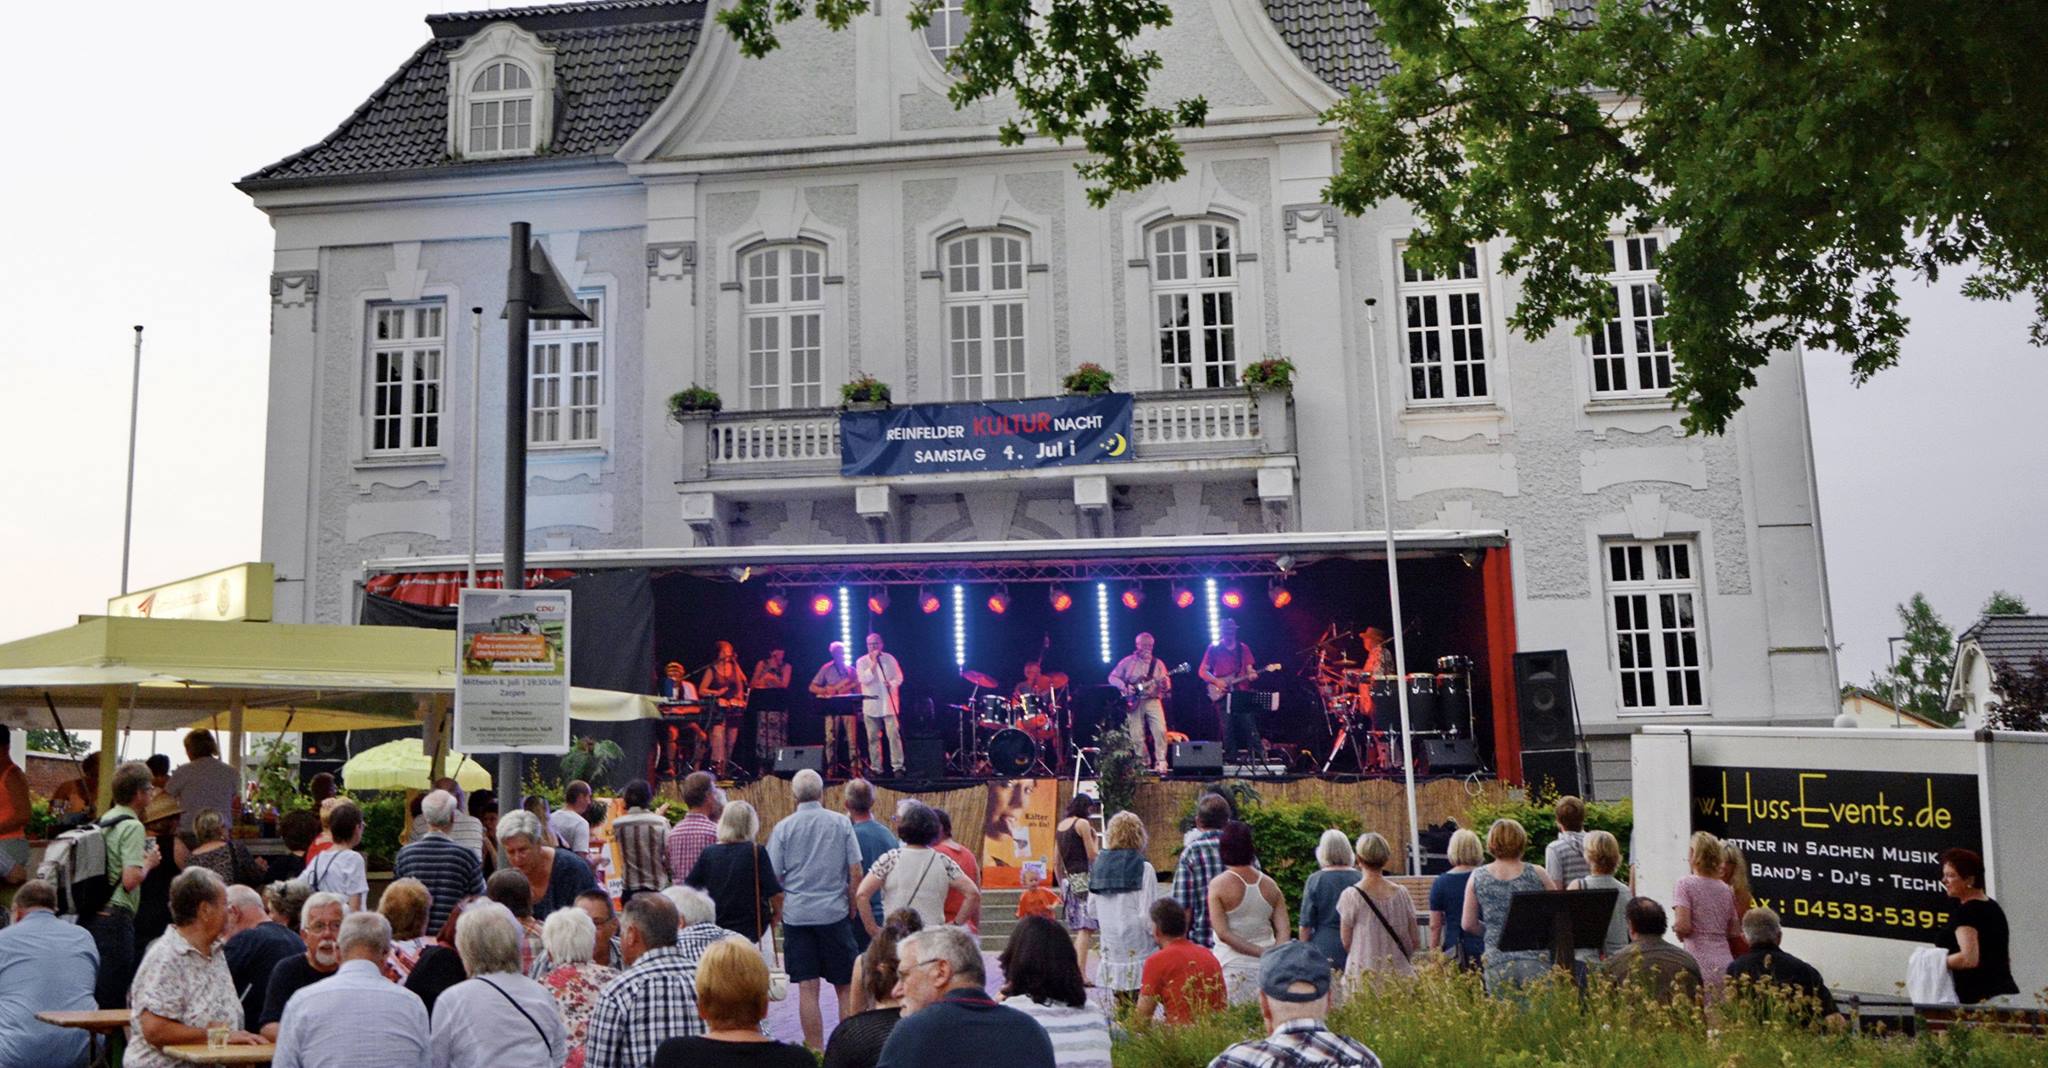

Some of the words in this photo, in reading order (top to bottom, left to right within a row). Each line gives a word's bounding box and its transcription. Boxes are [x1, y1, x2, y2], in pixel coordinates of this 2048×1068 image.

[886, 425, 965, 441] REINFELDER
[972, 412, 1051, 437] KULTUR
[1053, 415, 1103, 432] NACHT
[914, 448, 986, 463] SAMSTAG
[1003, 445, 1024, 461] 4.
[1782, 841, 1799, 854] IN
[1806, 841, 1875, 860] SACHEN
[1882, 846, 1940, 865] MUSIK
[1890, 874, 1949, 892] TECHN
